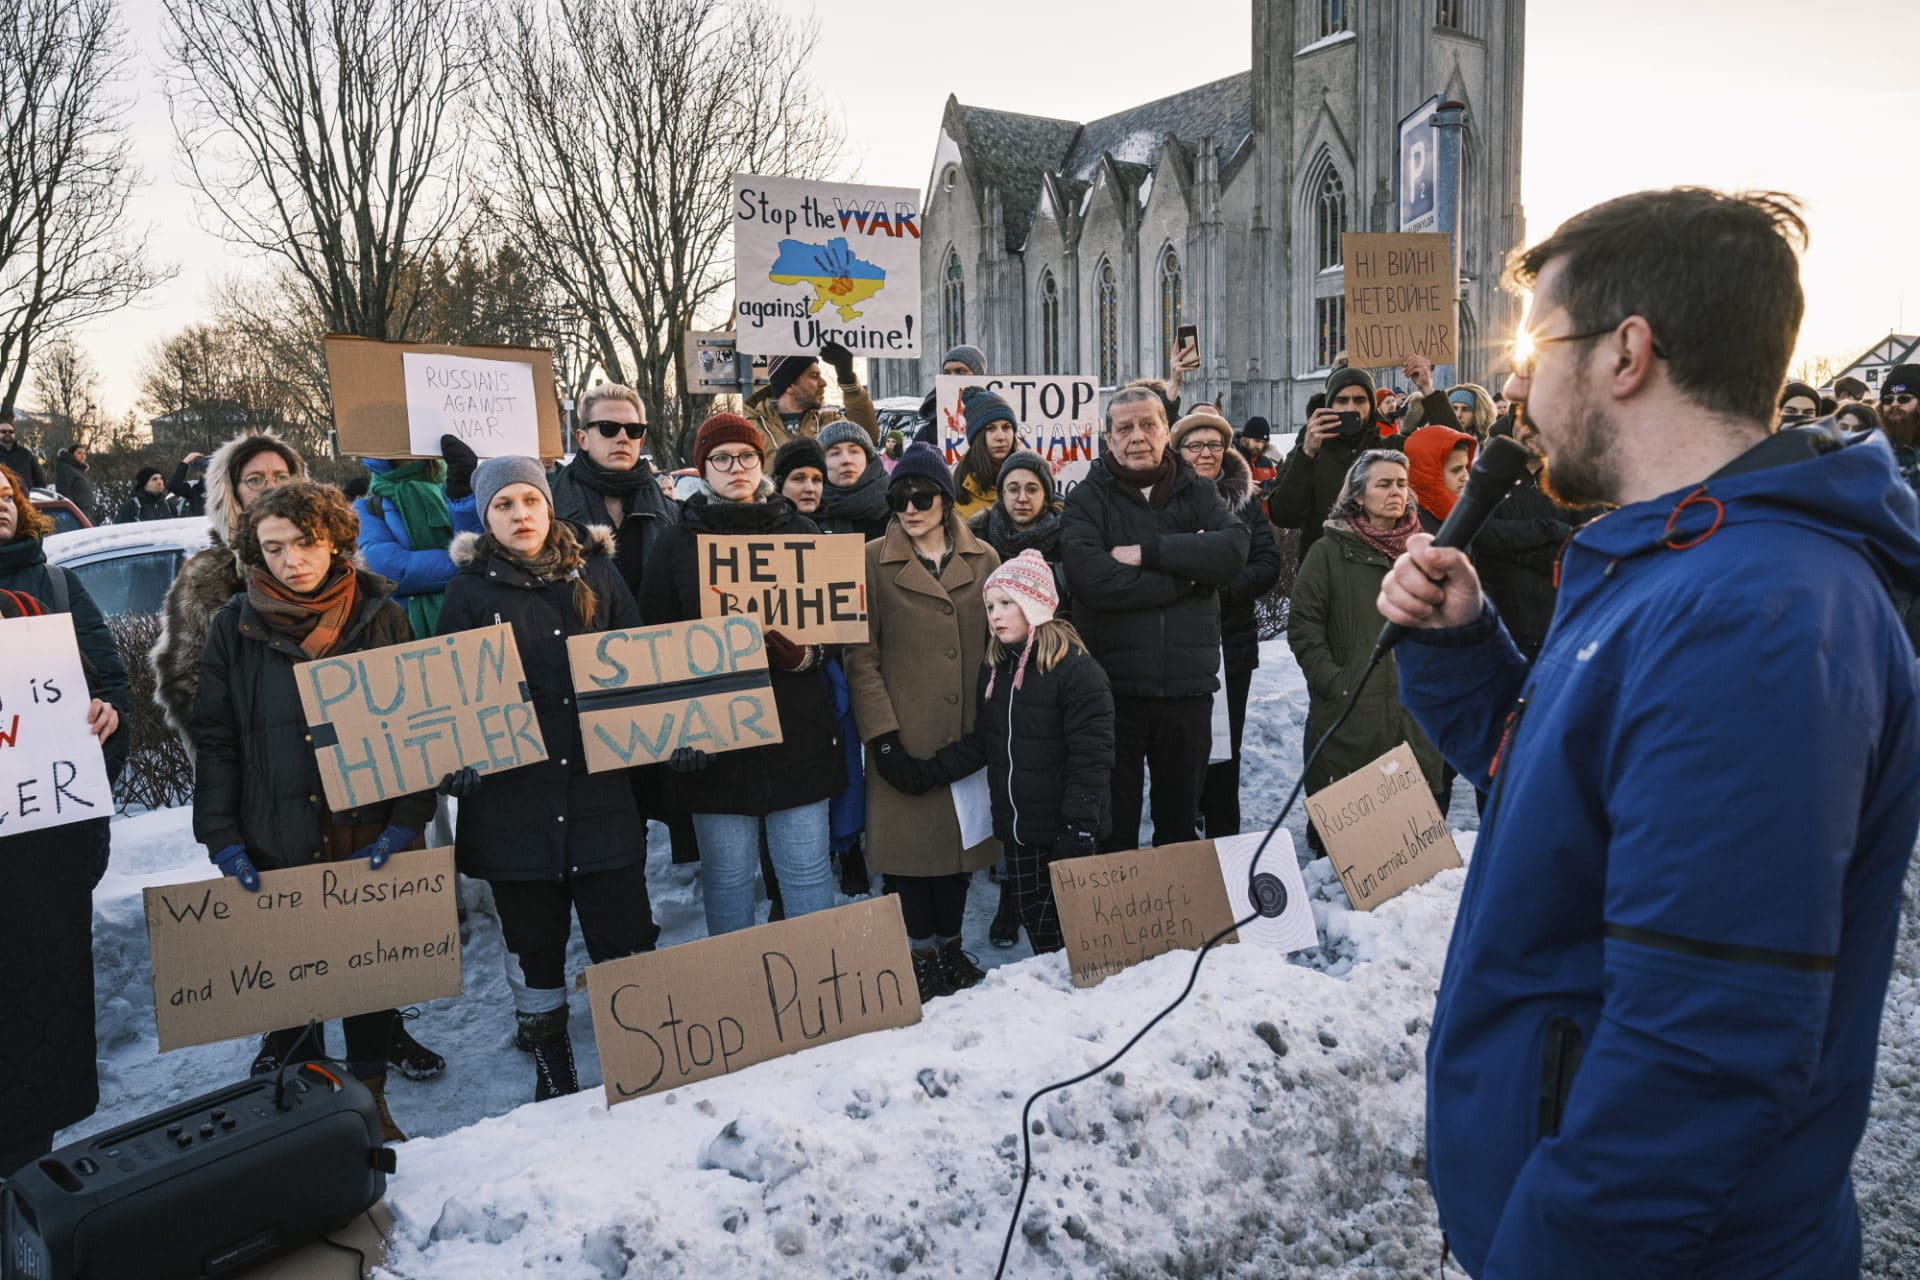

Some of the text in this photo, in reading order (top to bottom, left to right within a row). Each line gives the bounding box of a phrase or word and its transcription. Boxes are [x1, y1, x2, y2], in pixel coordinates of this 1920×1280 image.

[1410, 141, 1425, 204] P
[738, 188, 920, 239] Stop the WAR
[1355, 247, 1435, 279] НІ ВІЙНІ
[1352, 284, 1441, 315] НЕТ ВОЙНЕ
[738, 295, 914, 350] against Ukraine!
[1408, 323, 1452, 357] WAR
[425, 366, 511, 392] RUSSIANS
[443, 394, 518, 414] AGAINST
[985, 380, 1094, 422] TOP
[453, 416, 505, 440] WAR
[708, 541, 816, 585] НЕТ
[588, 616, 763, 689] STOP
[30, 678, 62, 704] is
[592, 694, 776, 764] WAR
[1057, 864, 1139, 893] Hussein
[1342, 864, 1378, 901] Turn
[161, 889, 233, 924] We
[256, 889, 304, 911] are
[170, 978, 213, 1007] and
[230, 960, 277, 996] We
[289, 959, 329, 982] are
[611, 948, 903, 1097] Stop Putin
